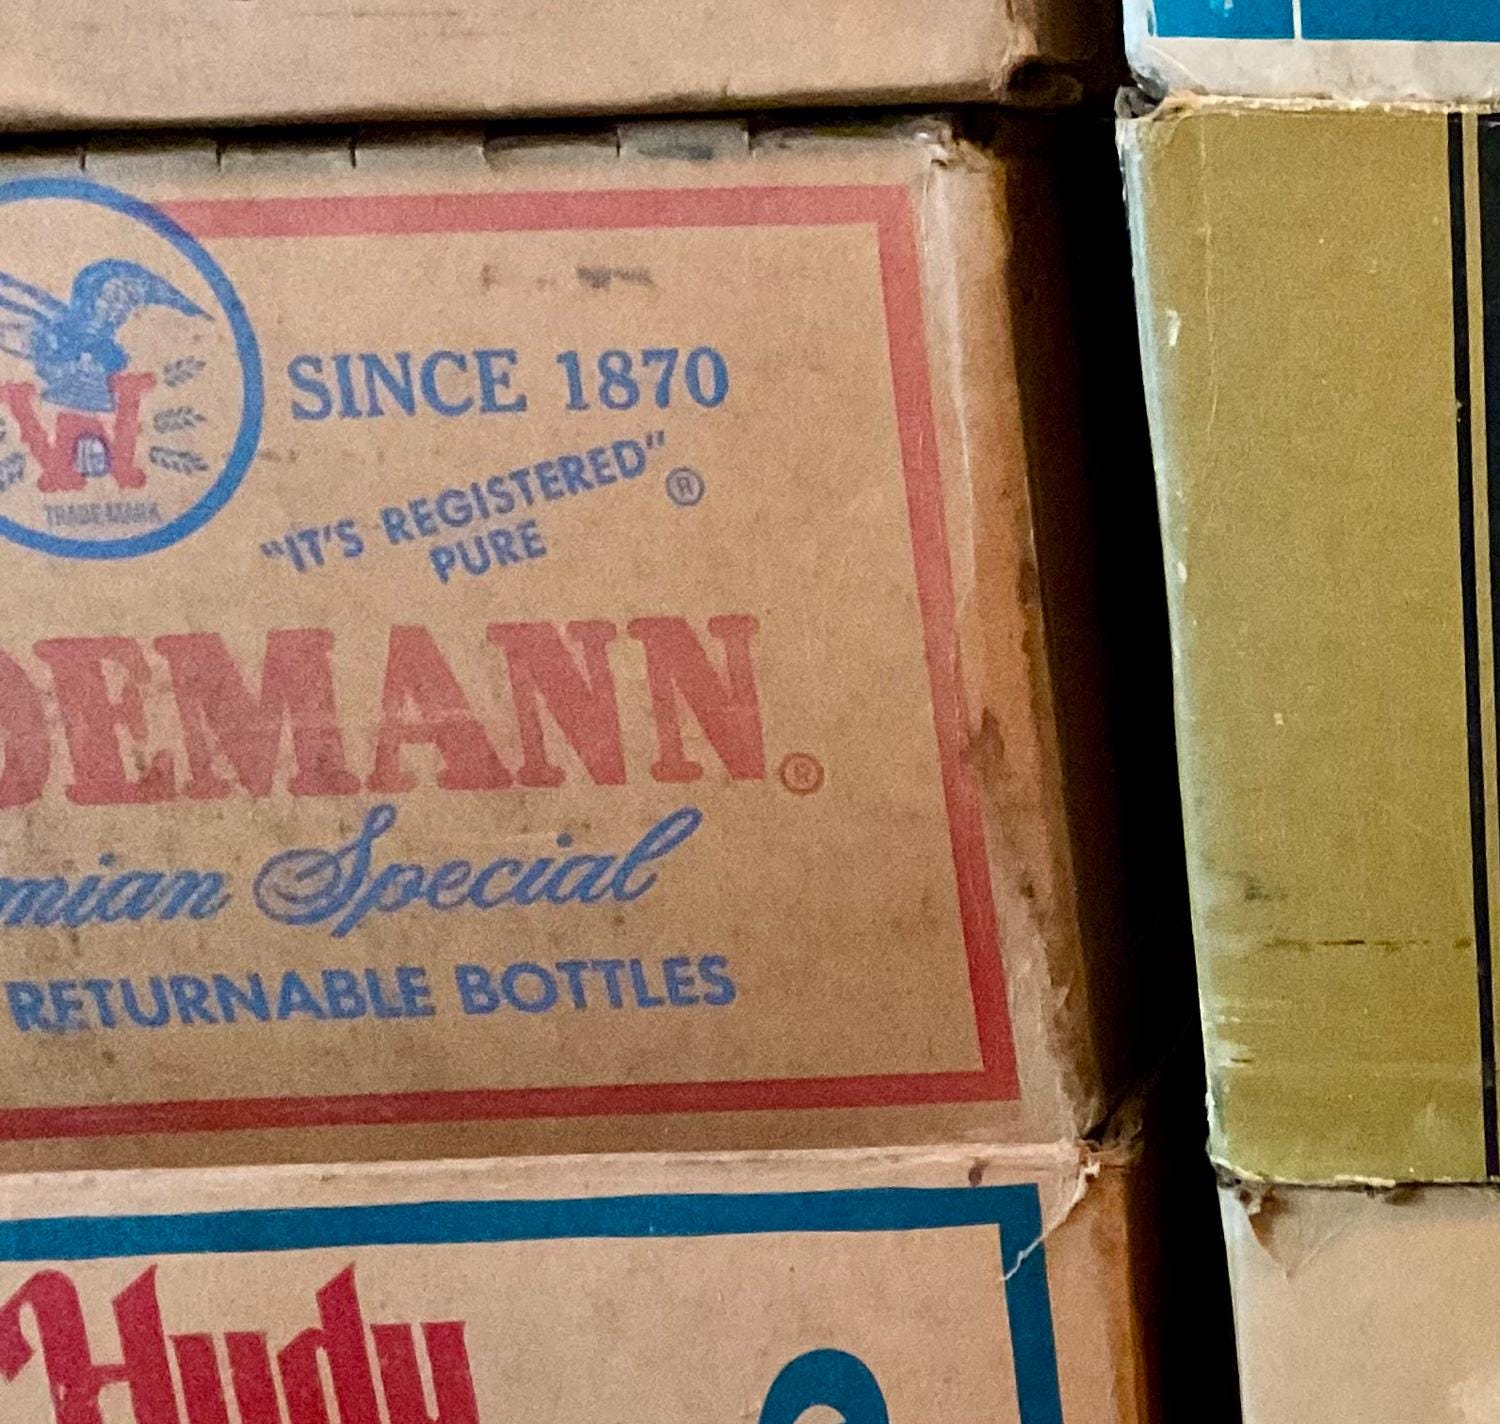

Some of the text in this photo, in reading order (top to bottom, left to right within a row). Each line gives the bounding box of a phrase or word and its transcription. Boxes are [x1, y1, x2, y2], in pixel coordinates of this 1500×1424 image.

[287, 344, 731, 422] SINCE 1870
[428, 520, 548, 584] PURE
[252, 803, 704, 940] Special
[7, 955, 737, 1034] RETURNABLE BOTTLES
